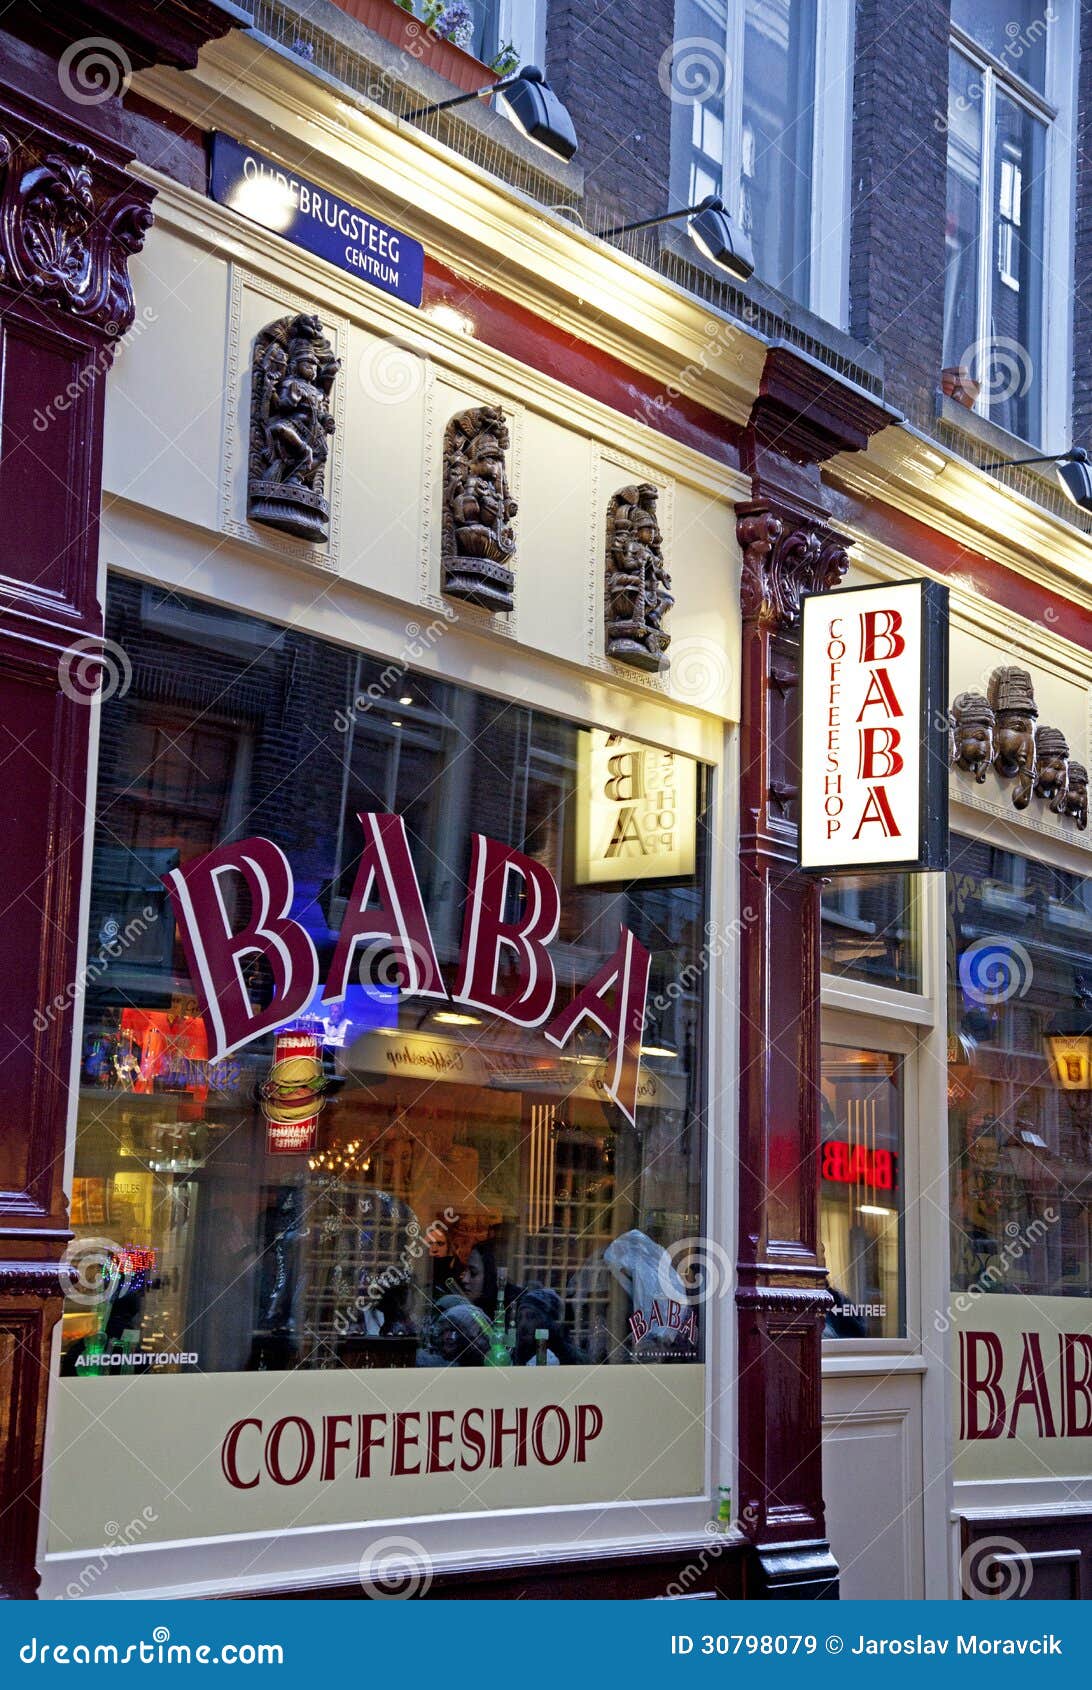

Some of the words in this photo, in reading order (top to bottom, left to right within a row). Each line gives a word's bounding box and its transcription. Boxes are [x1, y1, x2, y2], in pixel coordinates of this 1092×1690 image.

[345, 246, 399, 287] CENTRUM
[824, 618, 846, 840] COFFEESHOP
[852, 609, 905, 840] BABA
[162, 812, 652, 1128] BABA
[628, 1298, 699, 1345] BABA
[843, 1304, 887, 1316] ENTREE
[74, 1352, 199, 1367] AIRCONDITIONED
[221, 1403, 603, 1489] COFFEESHOP
